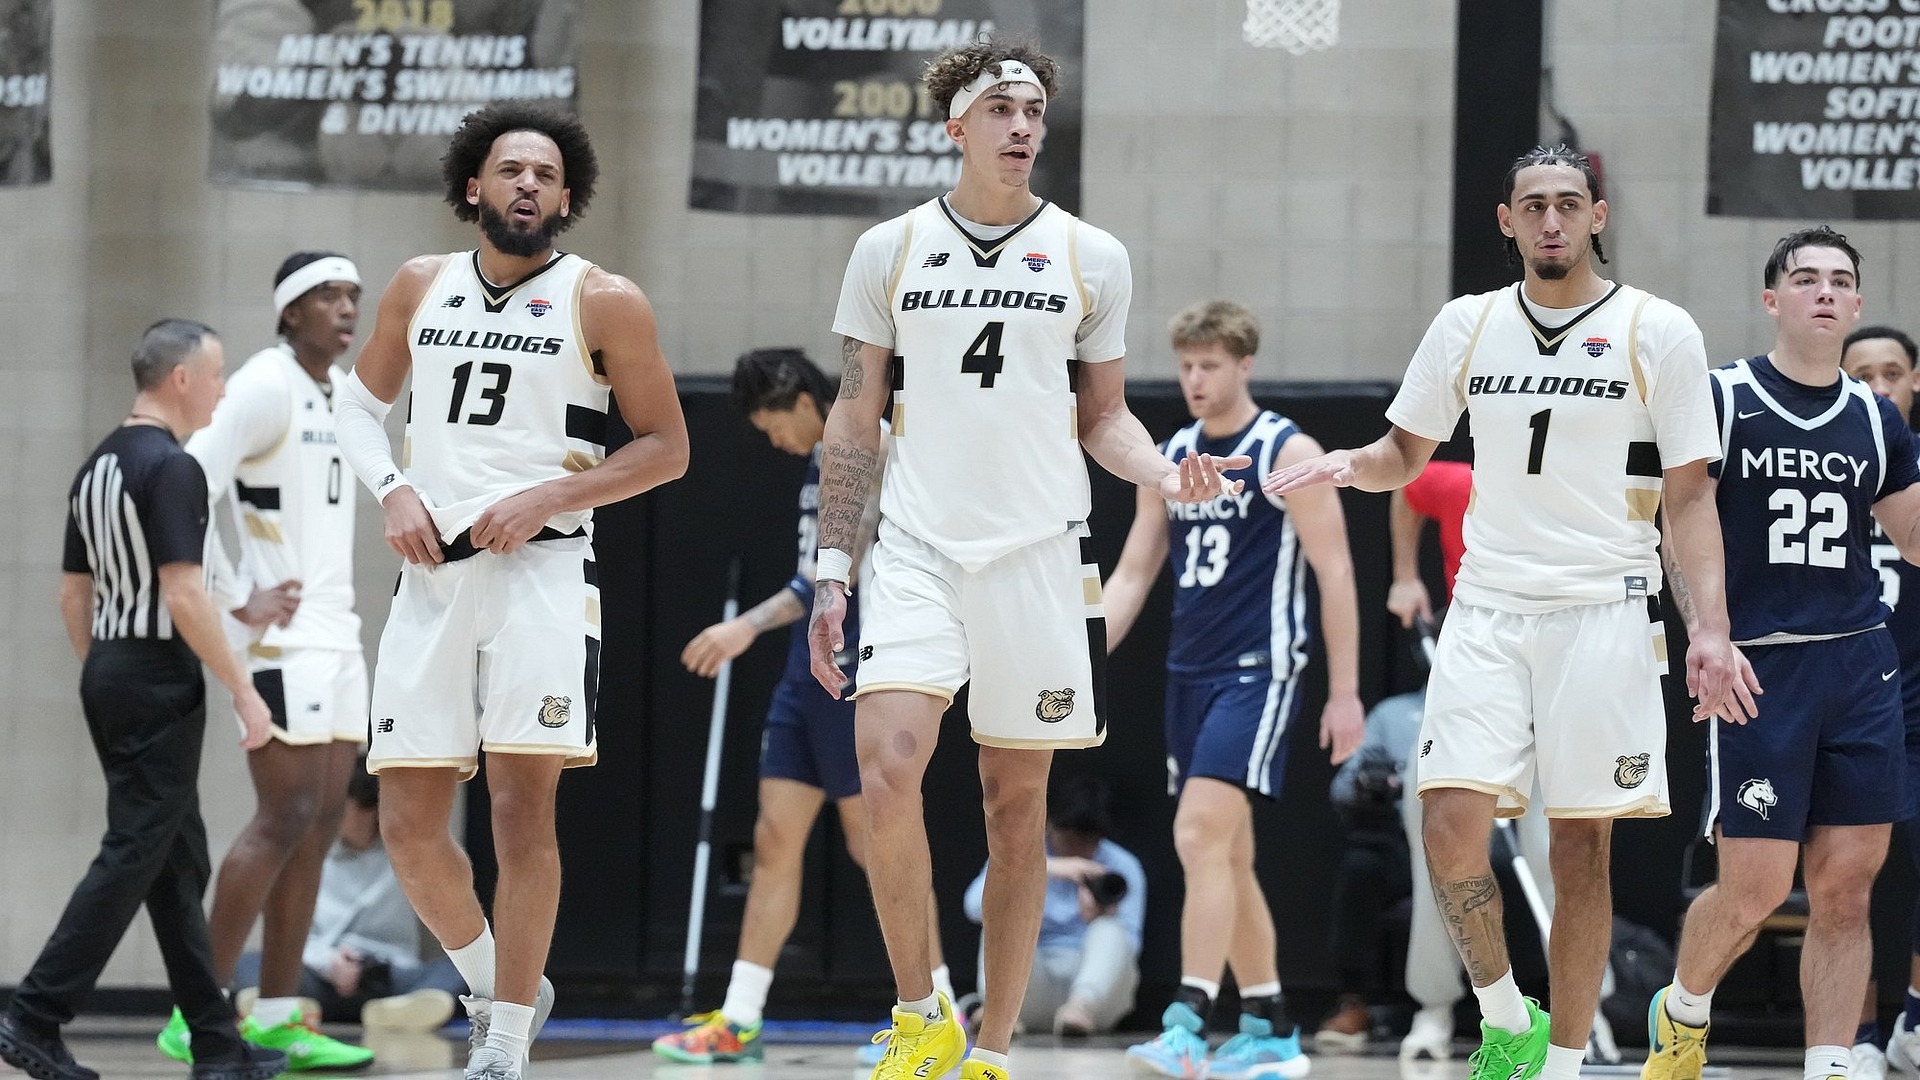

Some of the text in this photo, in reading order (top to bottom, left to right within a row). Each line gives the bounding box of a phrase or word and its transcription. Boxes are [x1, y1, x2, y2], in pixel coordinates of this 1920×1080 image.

[277, 34, 527, 67] MEN'S TENNIS
[217, 67, 387, 100] WOMEN'S
[727, 118, 899, 152] WOMEN'S
[1800, 157, 1920, 191] VOLLE
[901, 289, 1068, 314] BULLDOGS
[417, 328, 564, 356] BULLDOGS
[961, 321, 1004, 388] 4
[447, 361, 512, 426] 13
[1469, 375, 1629, 400] BULLDOGS
[1527, 408, 1552, 475] 1
[1741, 447, 1869, 488] MERCY
[1768, 488, 1848, 569] 22
[1179, 525, 1231, 588] 13
